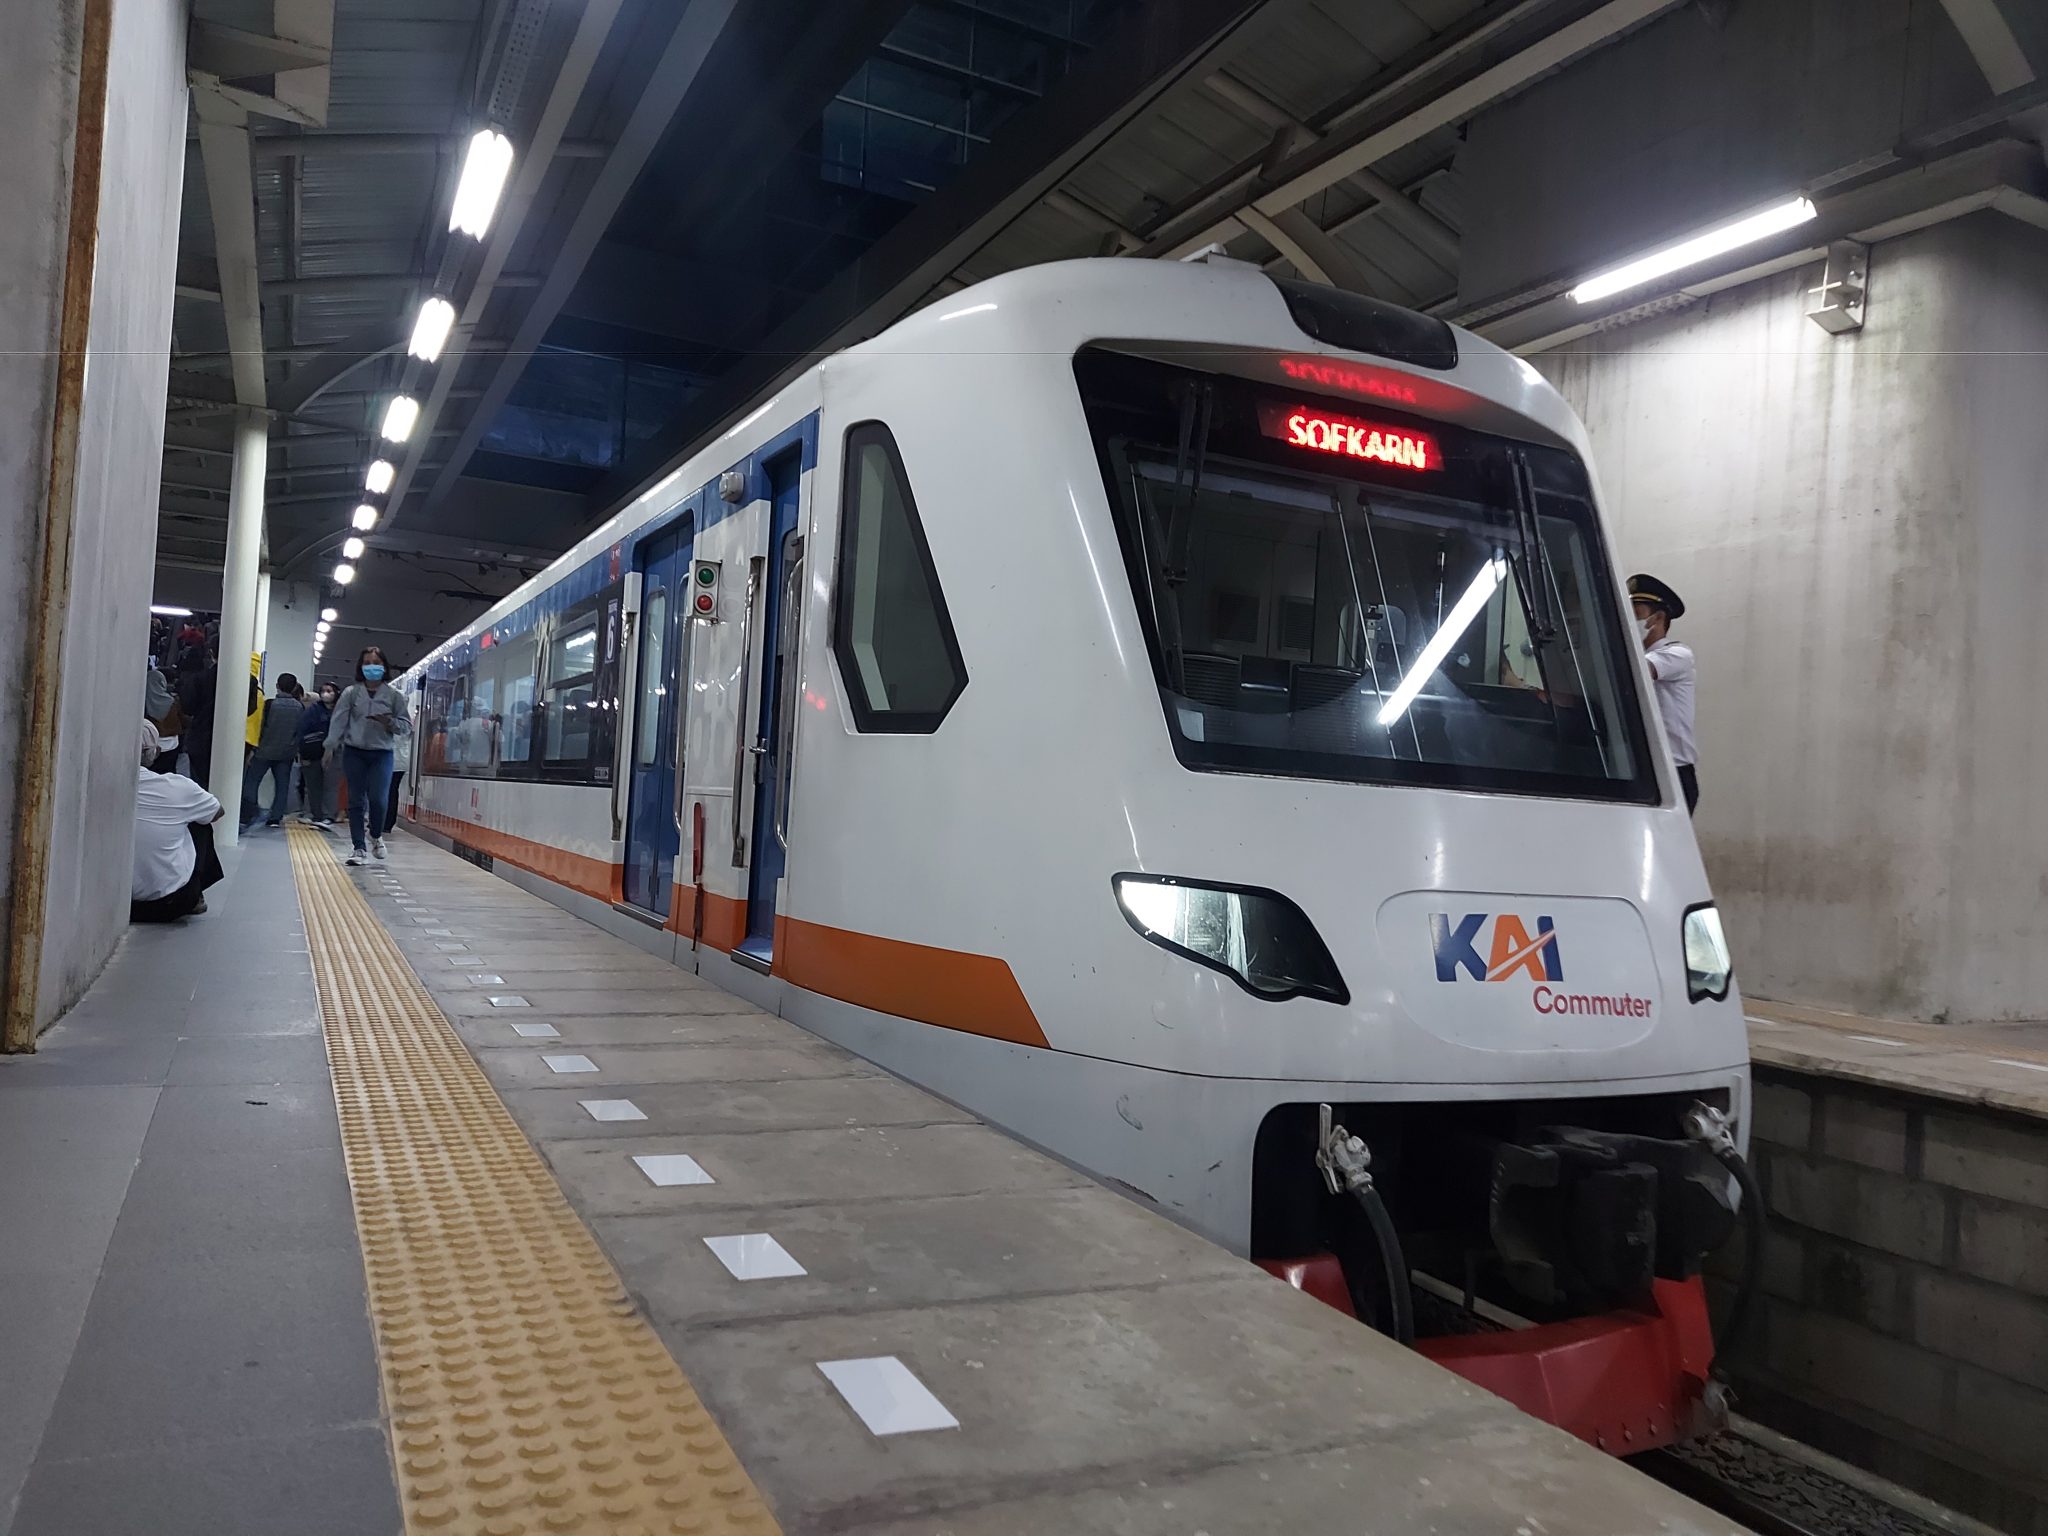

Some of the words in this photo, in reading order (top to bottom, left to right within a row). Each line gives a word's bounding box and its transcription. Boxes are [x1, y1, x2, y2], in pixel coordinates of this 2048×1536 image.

[607, 615, 615, 659] 6
[1428, 913, 1564, 982] KAI
[1533, 986, 1652, 1018] Commuter
